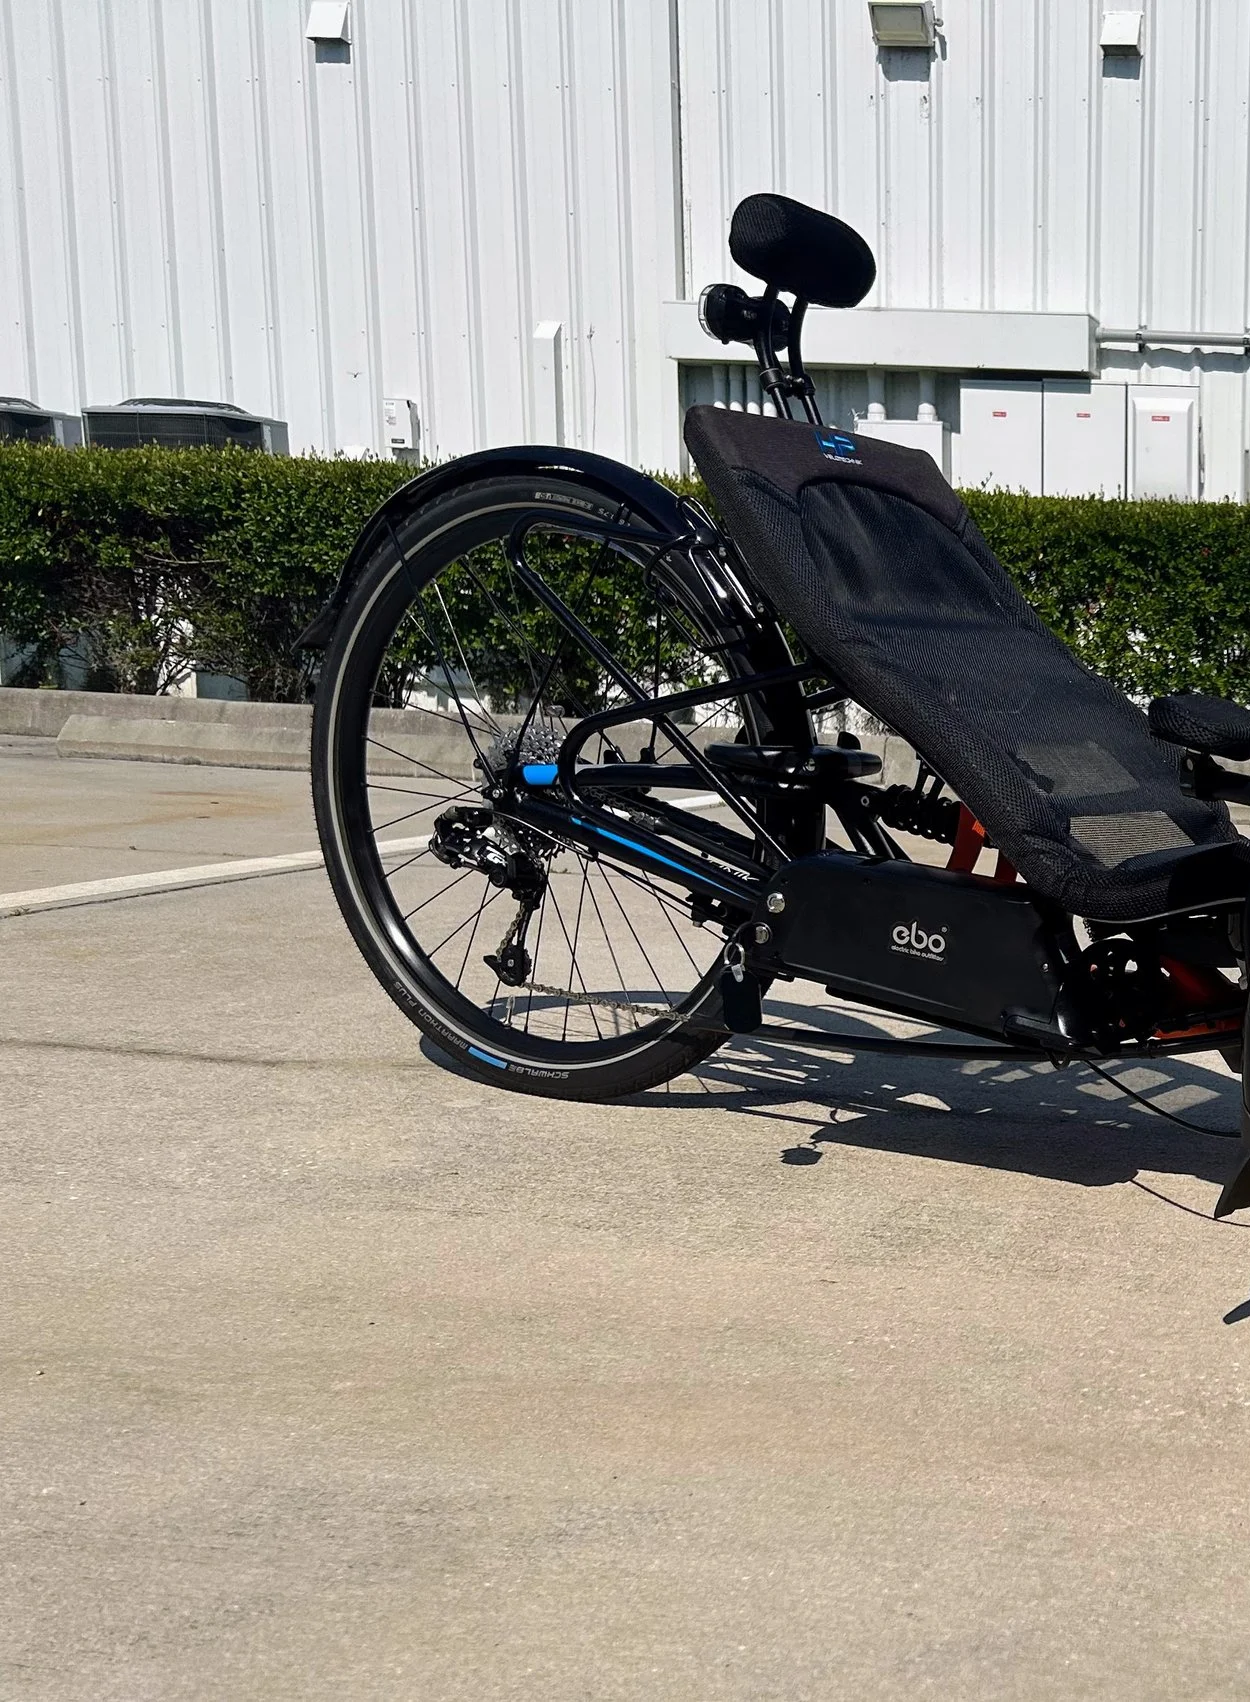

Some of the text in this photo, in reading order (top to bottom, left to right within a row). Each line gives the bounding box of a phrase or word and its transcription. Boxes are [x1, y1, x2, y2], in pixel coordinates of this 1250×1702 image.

[892, 921, 946, 954] ebo
[394, 981, 469, 1051] MARATHON PLUS
[508, 1064, 570, 1080] SCHWALBE
